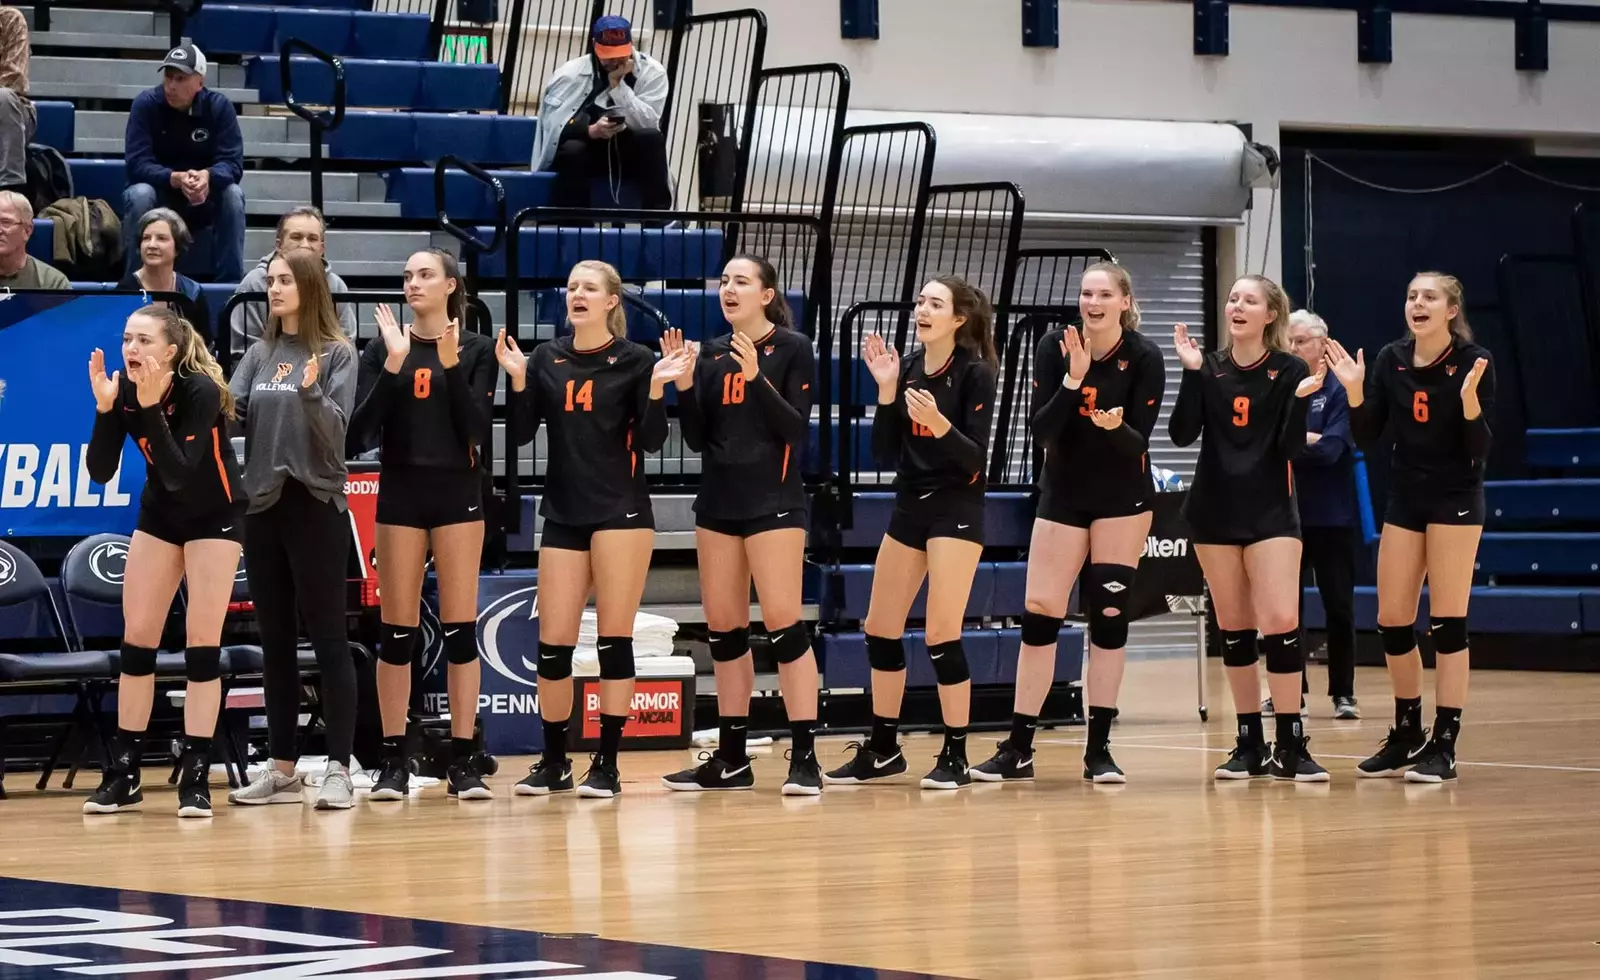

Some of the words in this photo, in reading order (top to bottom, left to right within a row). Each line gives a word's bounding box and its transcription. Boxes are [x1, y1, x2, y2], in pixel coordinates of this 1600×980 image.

[255, 382, 298, 393] VOLLEYBAL
[414, 368, 432, 399] 8
[564, 380, 593, 412] 14
[722, 372, 746, 405] 18
[1079, 386, 1098, 417] 3
[1232, 396, 1250, 427] 9
[1413, 391, 1429, 423] 6
[0, 443, 131, 508] BALL
[477, 694, 539, 714] PENN
[586, 692, 679, 711] BARMOR
